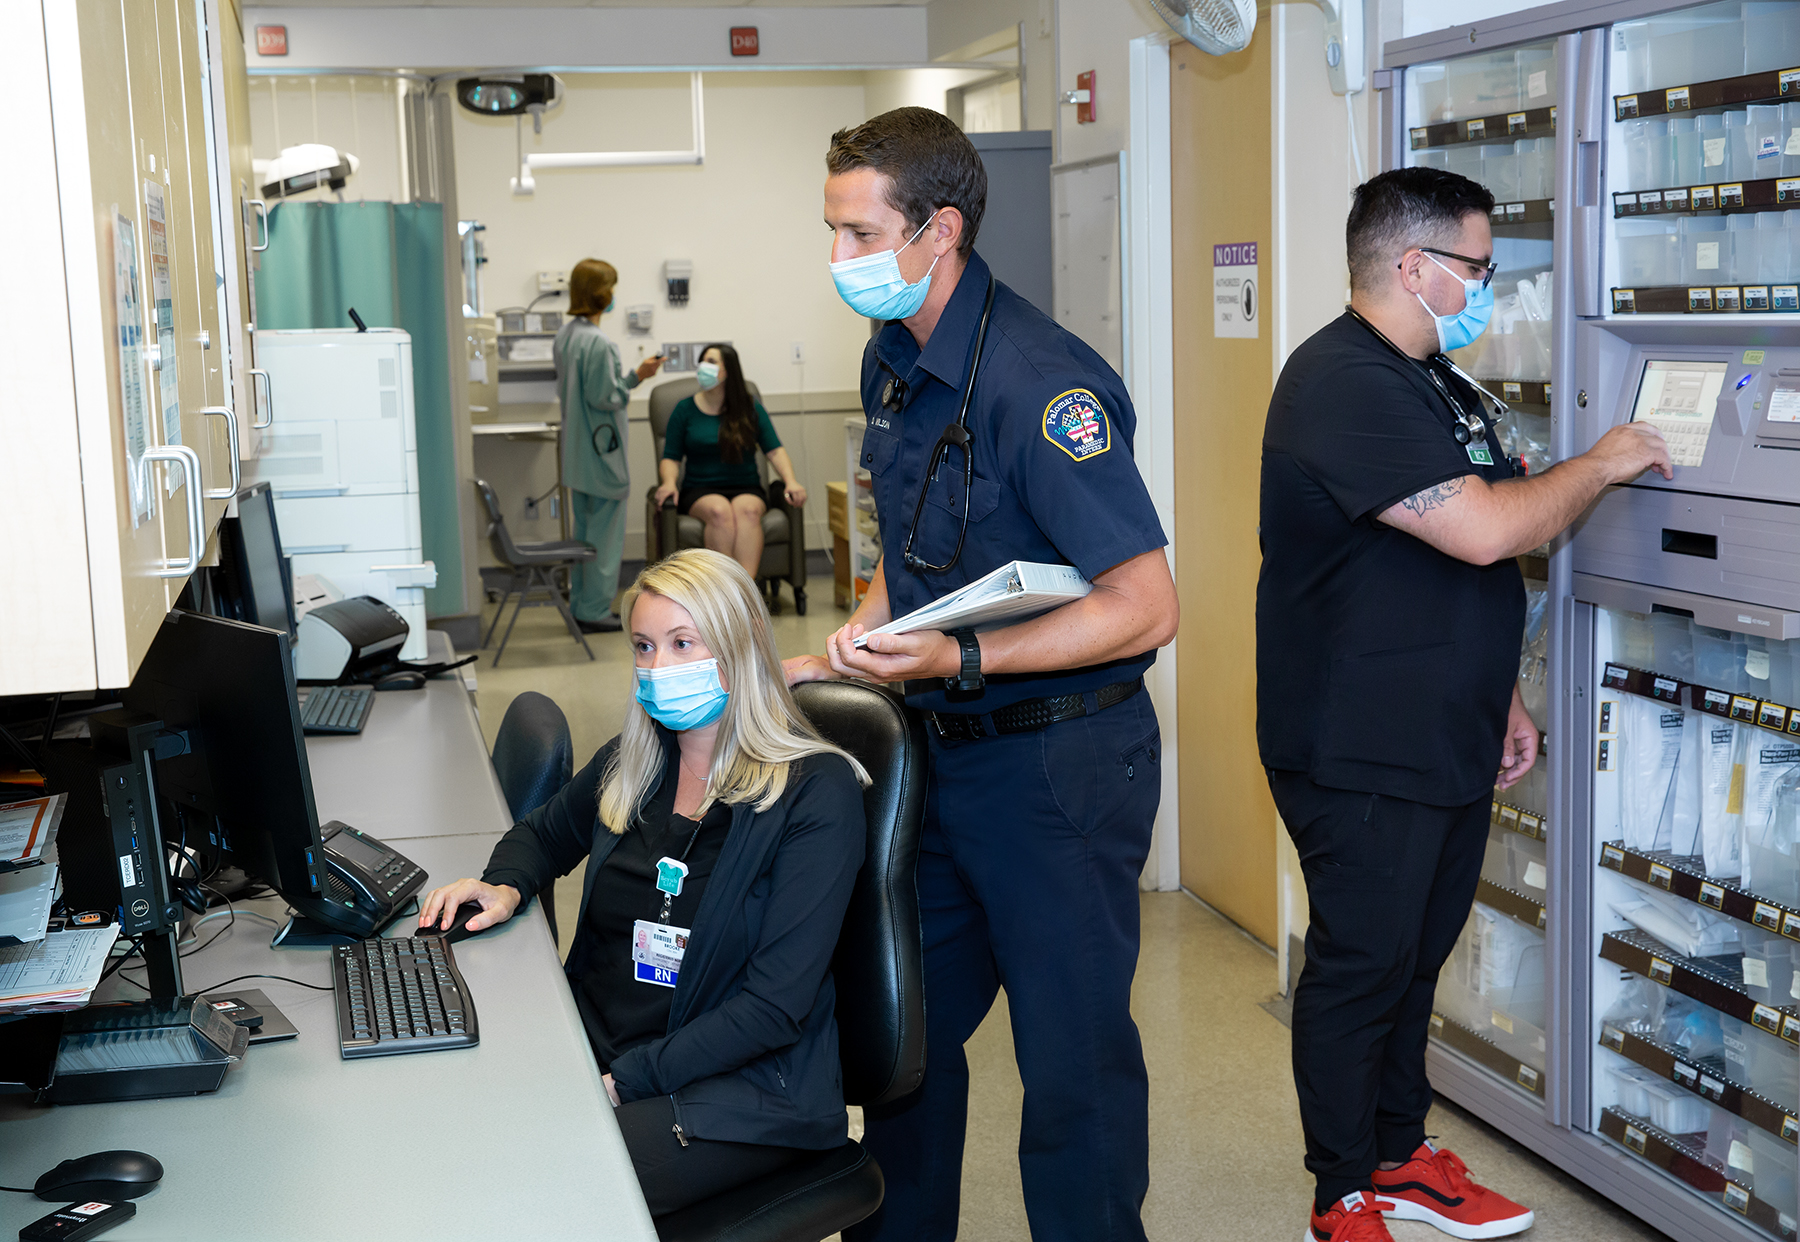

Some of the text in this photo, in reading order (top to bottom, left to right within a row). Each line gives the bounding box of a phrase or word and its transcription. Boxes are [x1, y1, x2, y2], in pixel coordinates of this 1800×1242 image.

[259, 33, 285, 48] D39
[732, 34, 757, 49] D40
[1216, 245, 1256, 264] NOTICE
[1046, 393, 1101, 425] Palomar College
[1074, 438, 1105, 453] PARAMEDIC
[1080, 444, 1103, 456] INTERN
[133, 904, 147, 912] DELL
[654, 968, 672, 982] RN
